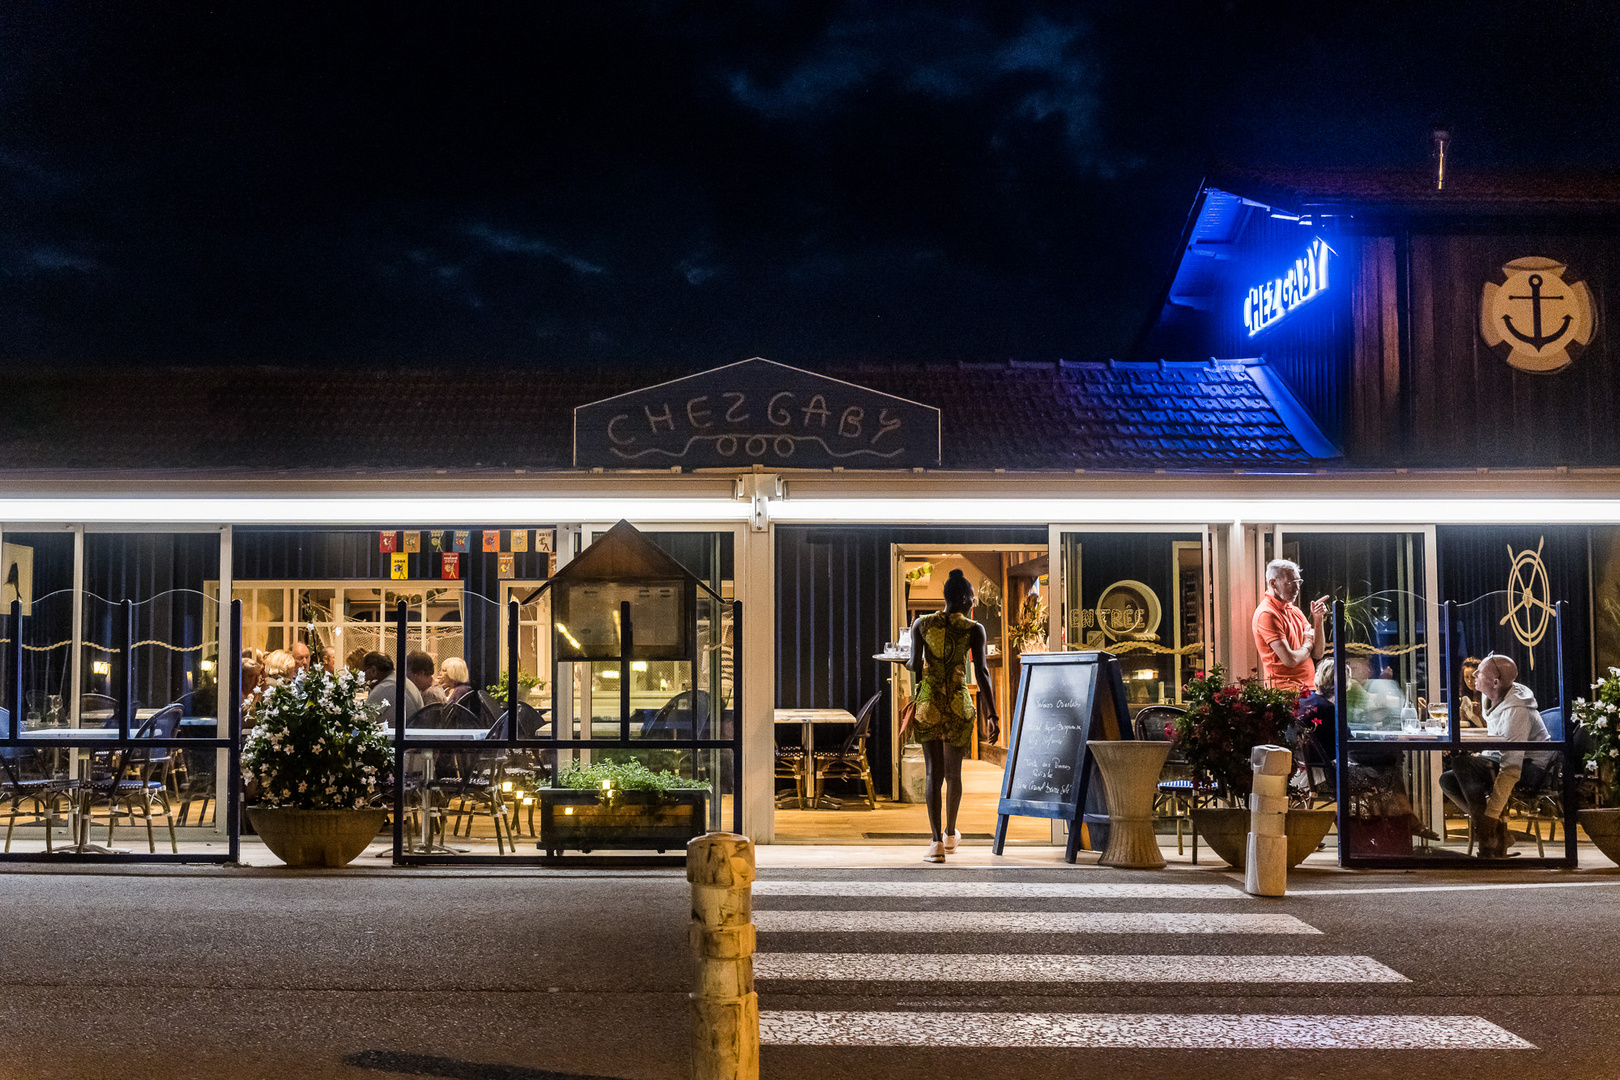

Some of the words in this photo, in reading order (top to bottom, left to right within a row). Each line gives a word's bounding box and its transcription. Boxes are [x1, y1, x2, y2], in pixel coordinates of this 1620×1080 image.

[1243, 279, 1284, 336] CHEZ
[606, 392, 750, 446] CHEZ
[766, 391, 902, 445] GABY
